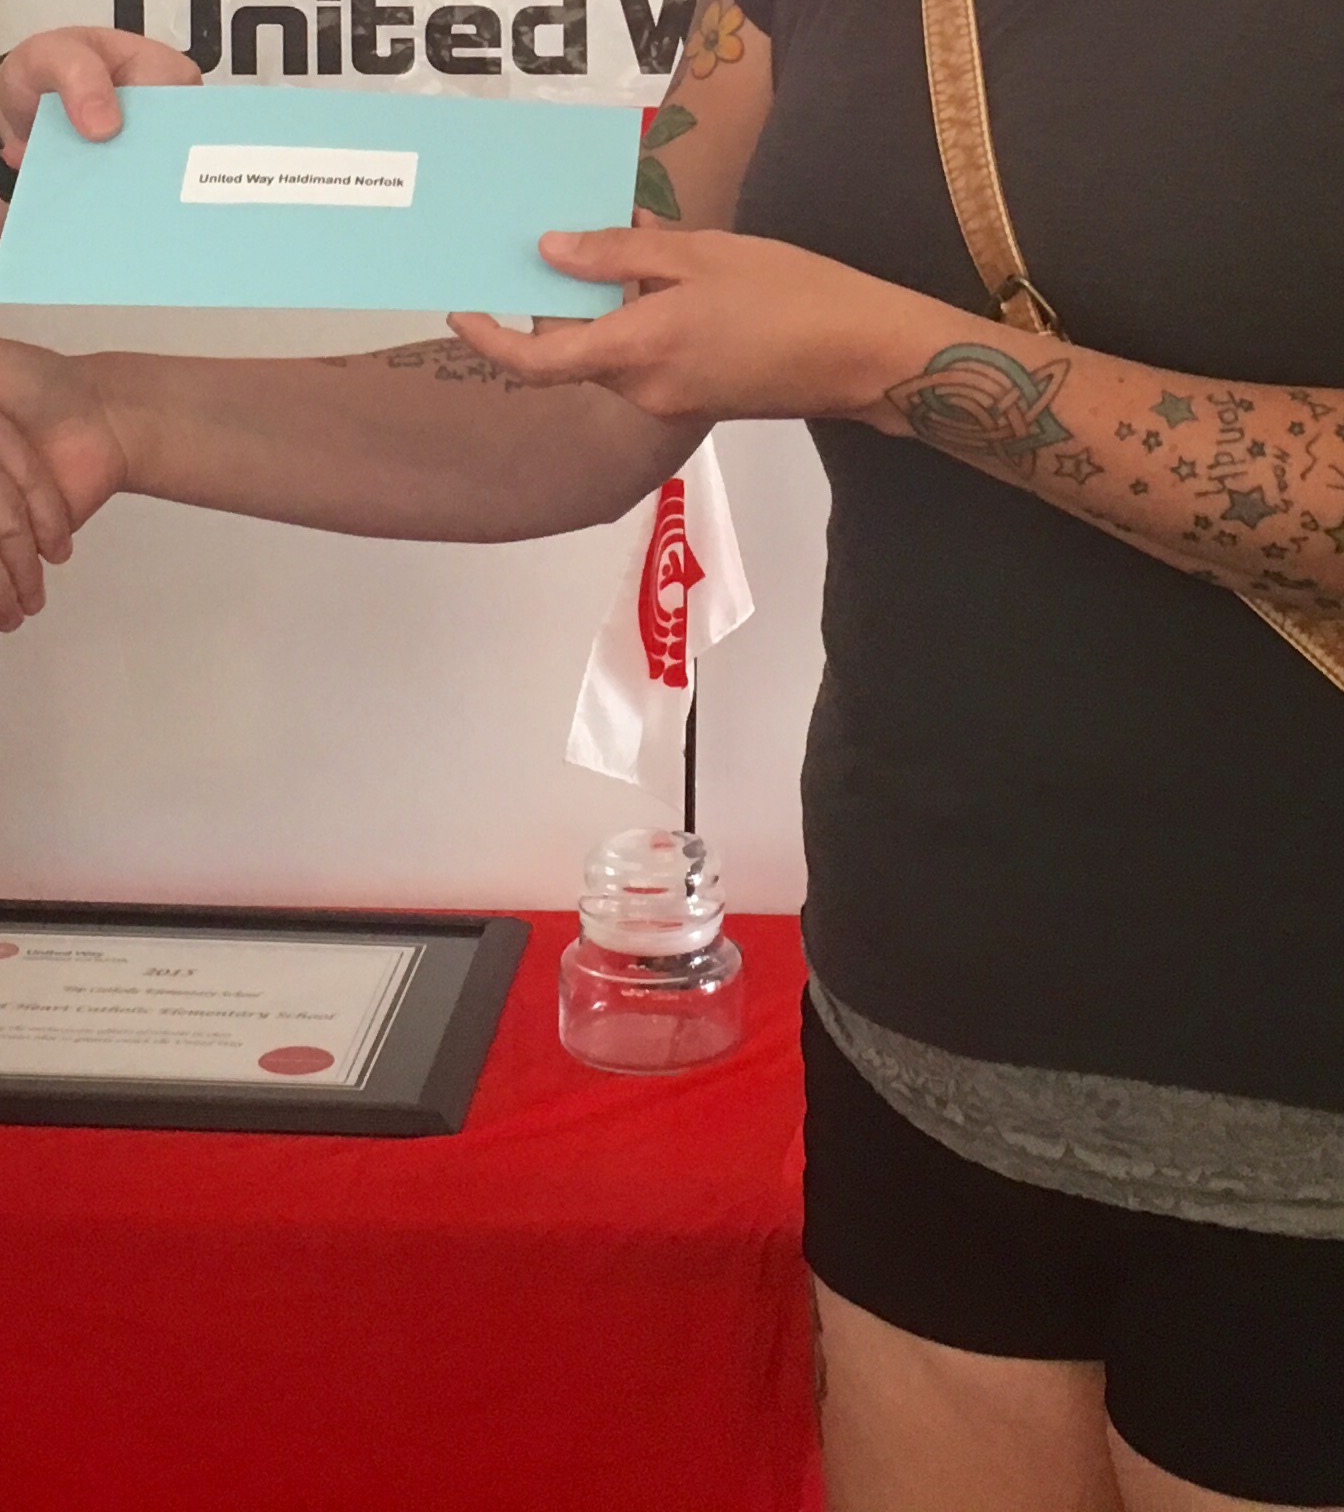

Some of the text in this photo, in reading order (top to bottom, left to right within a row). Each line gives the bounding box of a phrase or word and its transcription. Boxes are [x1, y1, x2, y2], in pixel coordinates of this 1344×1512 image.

[198, 173, 405, 188] United Way Haldimand Norfolk
